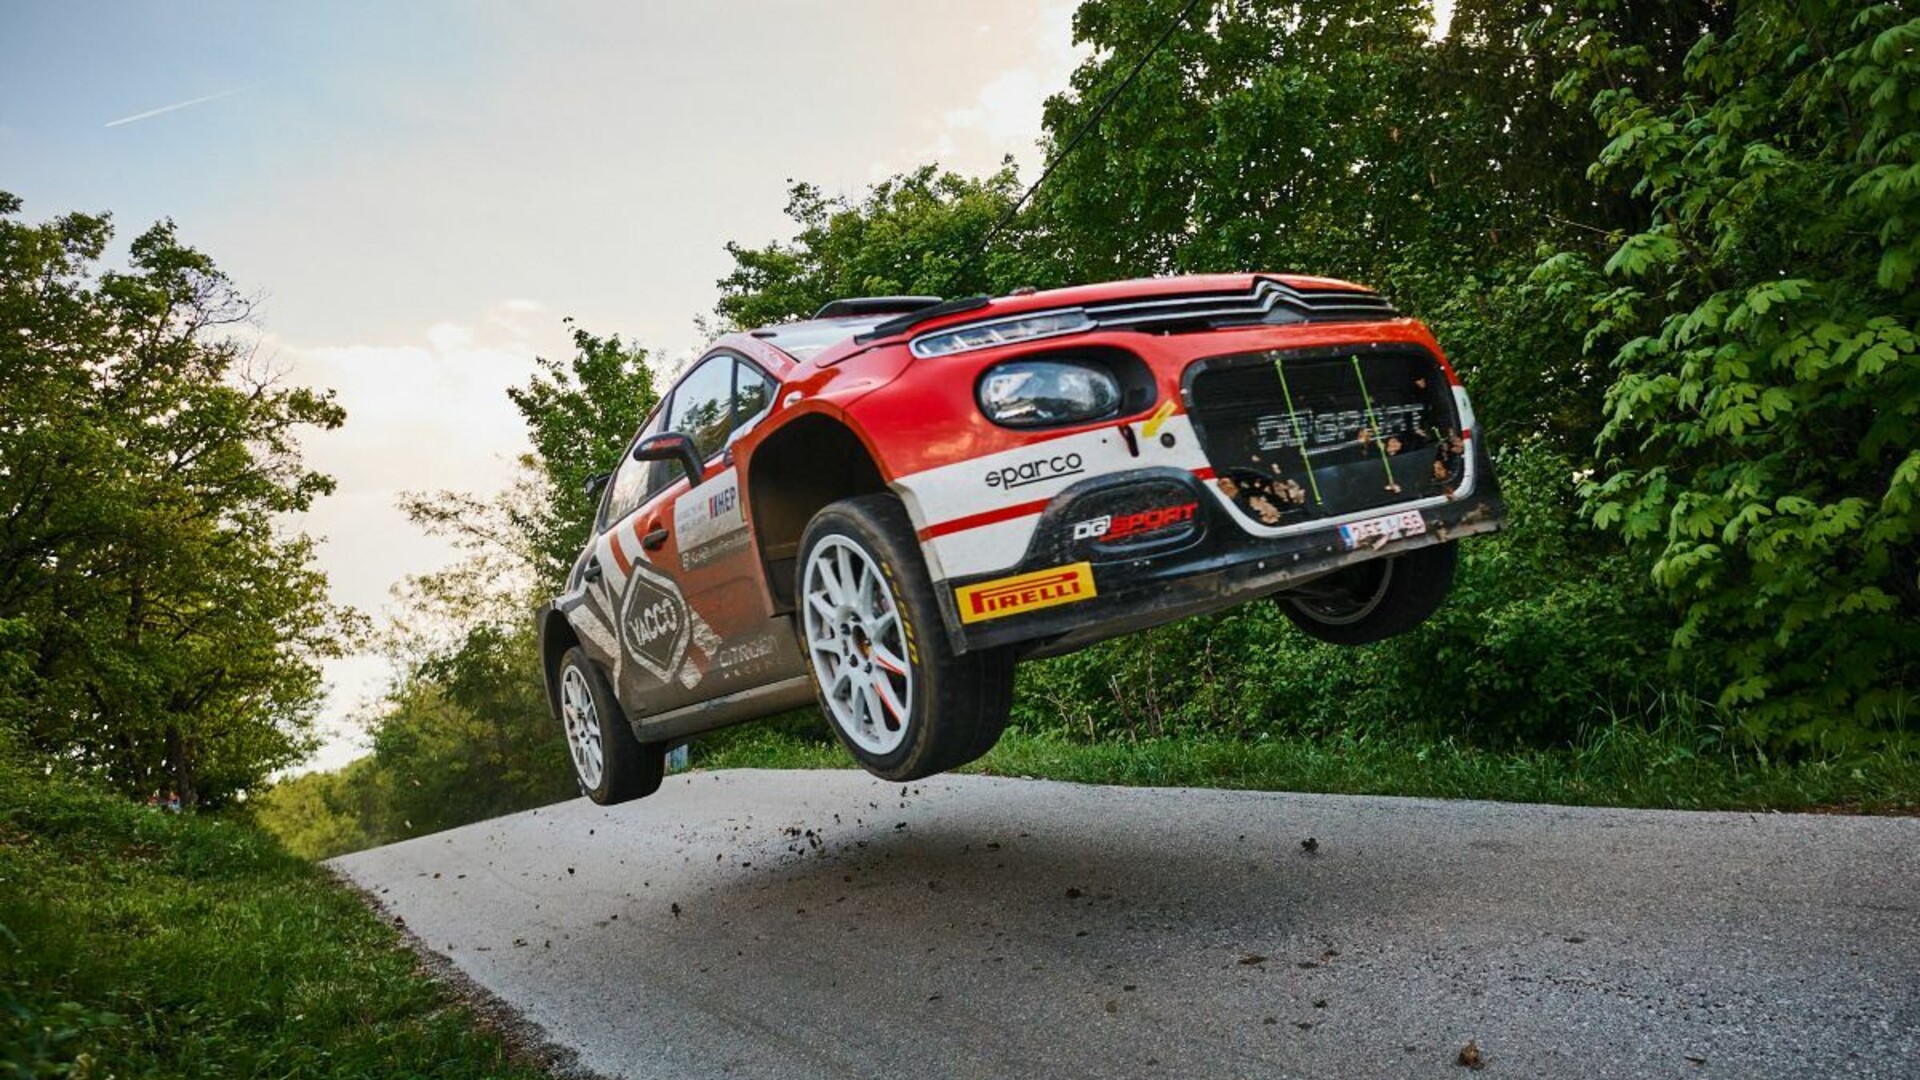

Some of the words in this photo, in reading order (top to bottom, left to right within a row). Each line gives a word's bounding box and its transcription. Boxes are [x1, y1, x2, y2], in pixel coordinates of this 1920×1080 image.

[985, 453, 1083, 490] sparco
[718, 486, 737, 515] HEP
[969, 571, 1081, 614] PIRELLI
[629, 598, 677, 646] YACCO
